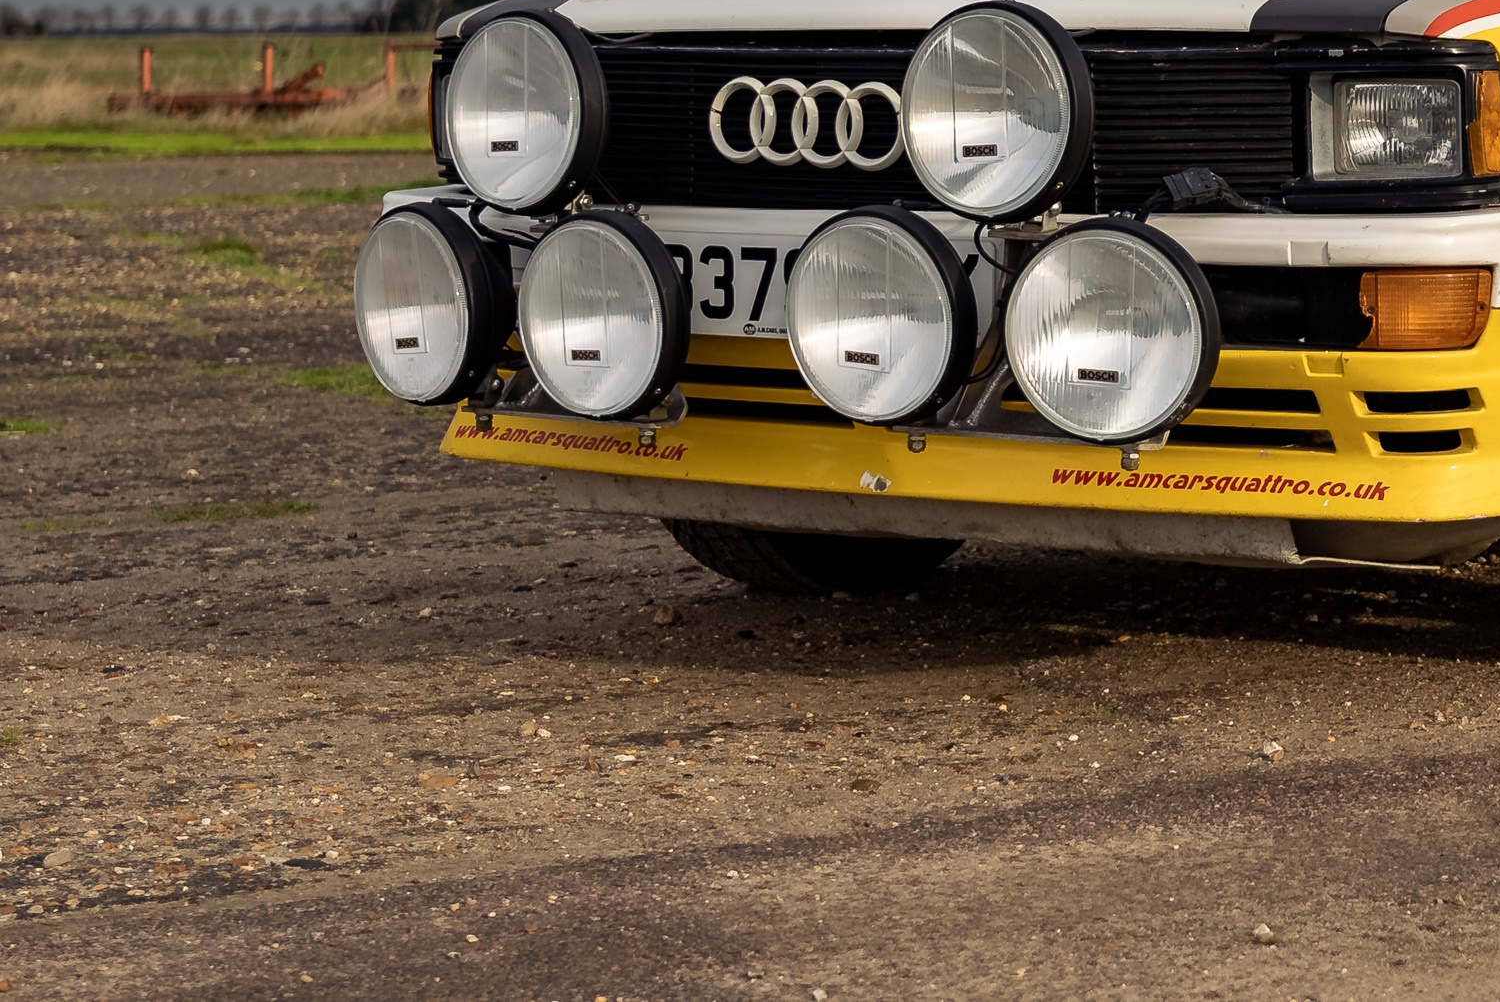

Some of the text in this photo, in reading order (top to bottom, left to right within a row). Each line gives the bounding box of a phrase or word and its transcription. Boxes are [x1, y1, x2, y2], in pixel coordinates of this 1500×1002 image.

[492, 142, 517, 151] BOSCH
[965, 145, 995, 156] BOSCH
[572, 350, 599, 360] BOSCH
[847, 352, 877, 365] BOSCH
[1080, 370, 1115, 382] BOSCH
[454, 424, 689, 462] www.amcarsquattro.co.uk
[1052, 467, 1391, 501] www.amcarsquattro.co.uk
